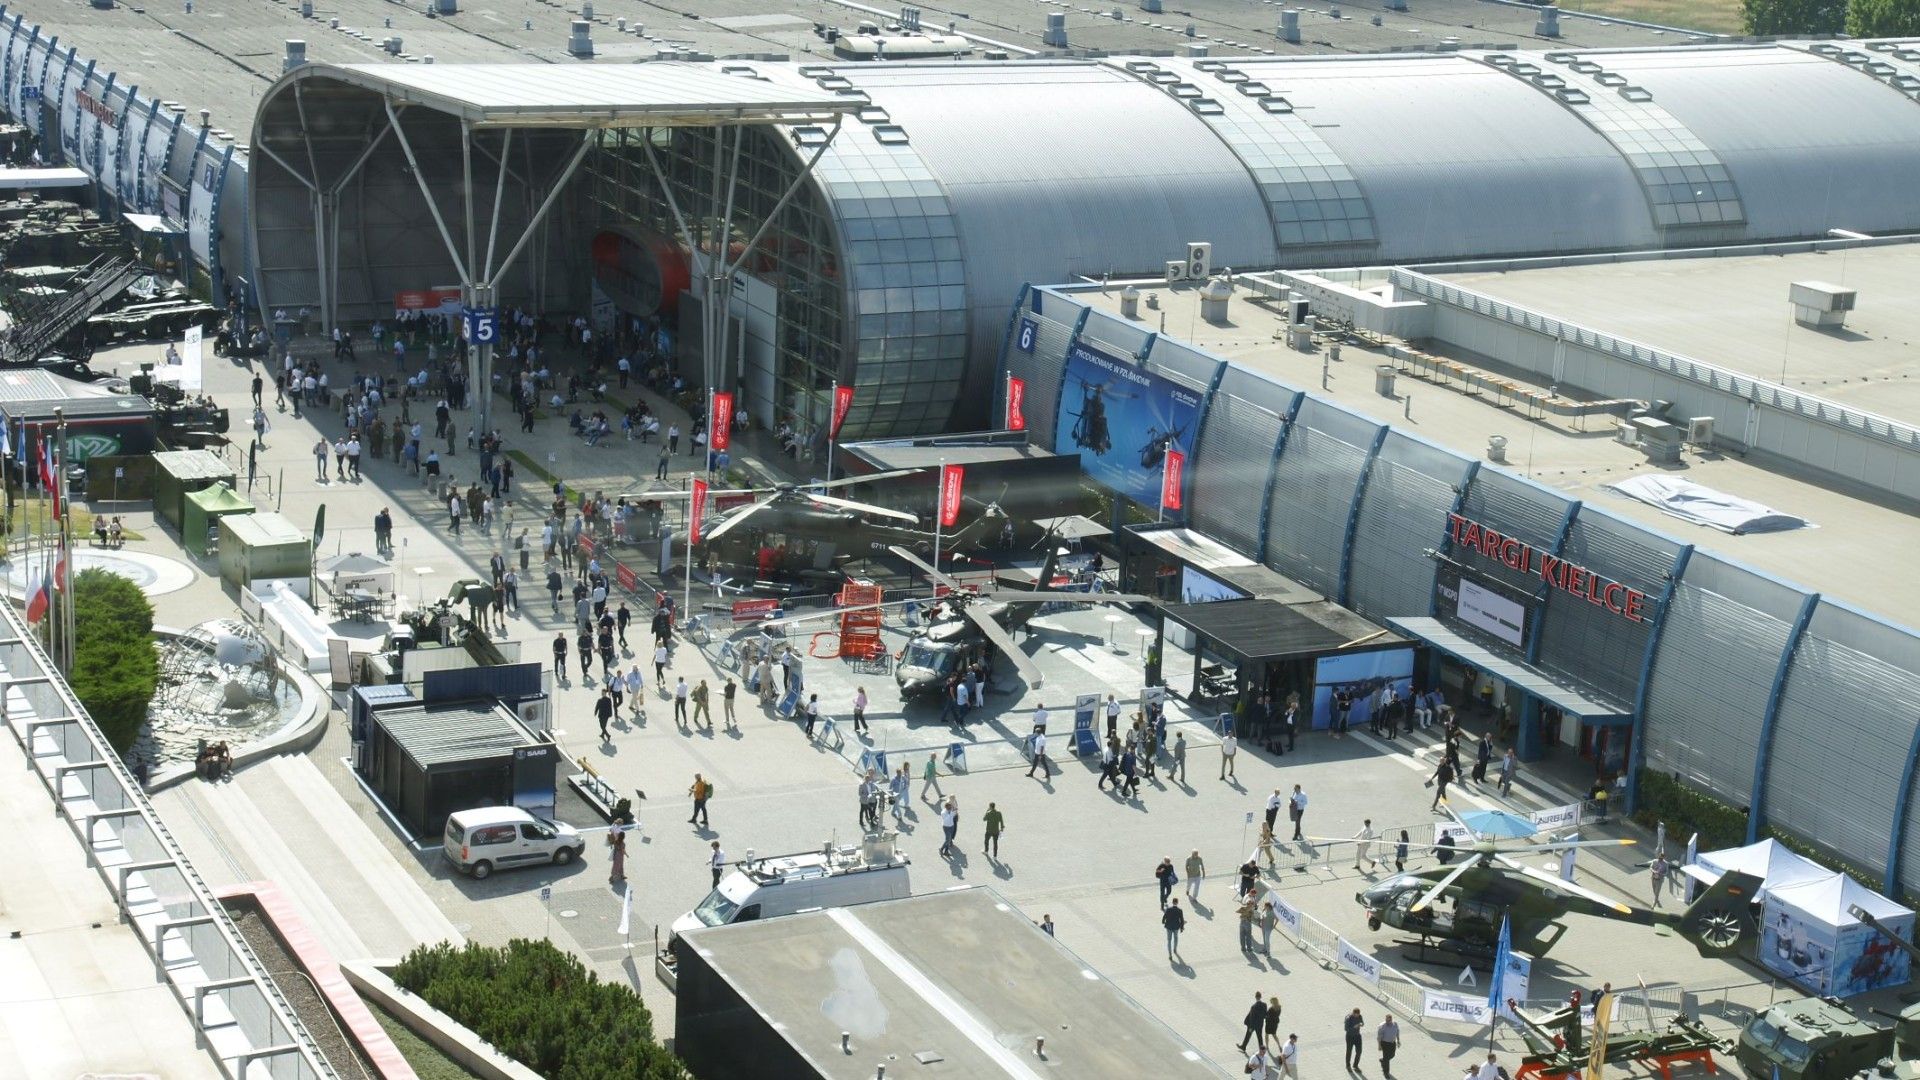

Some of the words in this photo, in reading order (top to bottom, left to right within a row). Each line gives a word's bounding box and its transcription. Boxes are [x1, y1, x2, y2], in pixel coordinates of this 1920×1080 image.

[463, 316, 470, 339] 5
[477, 318, 493, 341] 5
[1022, 327, 1032, 349] 6
[871, 541, 886, 550] 6711
[1450, 513, 1531, 574] TARGI
[1540, 552, 1646, 623] KIELCE
[526, 749, 547, 757] SAAB
[1537, 811, 1573, 825] AIRBUS
[1273, 900, 1296, 925] AIRBUS
[1344, 950, 1375, 975] AIRBUS
[1430, 1000, 1483, 1016] AIRBUS
